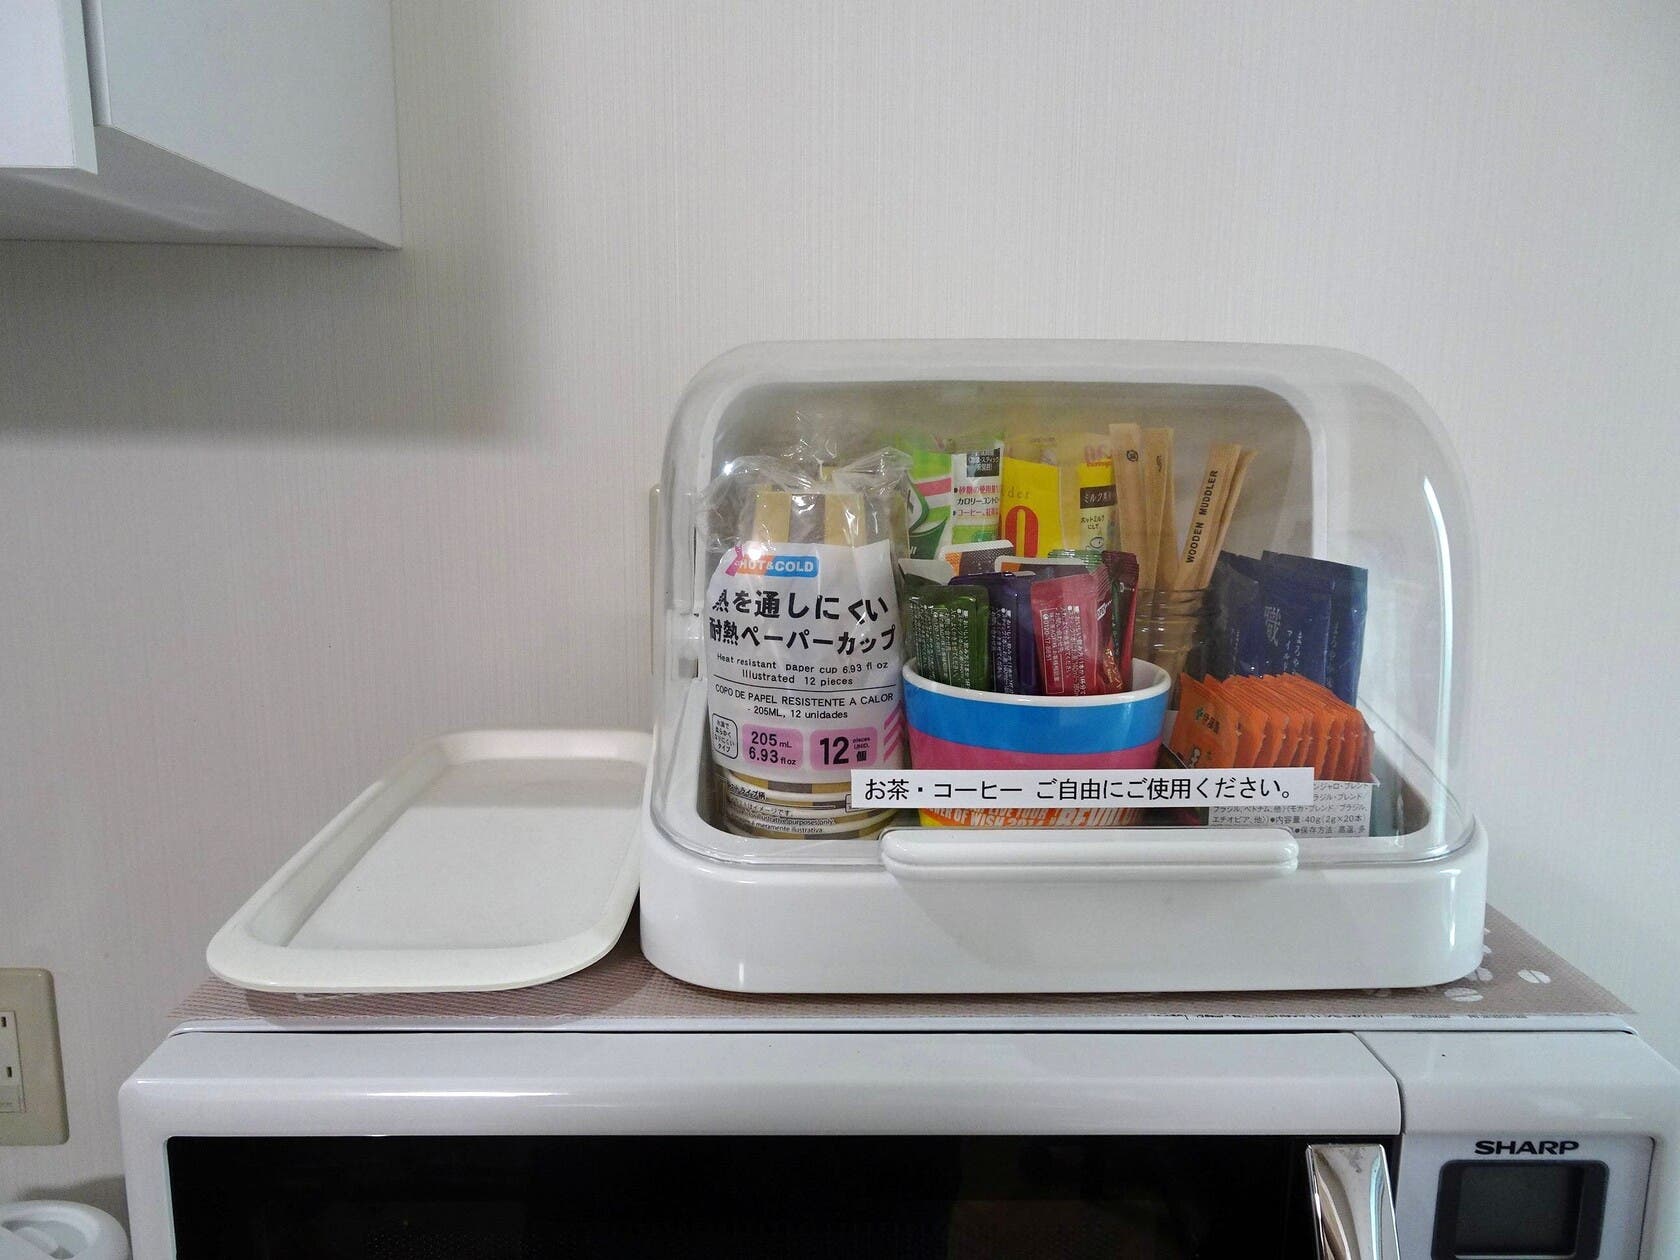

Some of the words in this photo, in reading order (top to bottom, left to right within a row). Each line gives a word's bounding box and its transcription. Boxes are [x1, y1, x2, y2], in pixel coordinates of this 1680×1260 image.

[1185, 522, 1204, 563] WOODEN
[1199, 470, 1218, 515] MUDDLER
[709, 617, 896, 656] 耐熱ペーパーカップ
[717, 652, 734, 664] Heat
[736, 658, 777, 669] resistant
[785, 664, 815, 673] paper
[819, 667, 838, 675] cup
[842, 663, 862, 674] 6.93
[876, 661, 889, 670] oz
[742, 669, 795, 684] Illustrated
[804, 676, 816, 686] 12
[820, 677, 853, 687] pieces
[715, 683, 734, 697] COPO
[735, 689, 746, 699] DE
[748, 692, 778, 704] PAPEL
[781, 695, 846, 707] RESISTENTE
[849, 697, 857, 706] A
[860, 692, 894, 705] CALOR
[791, 709, 802, 719] 12
[804, 711, 848, 719] unidades
[751, 731, 778, 746] 205
[748, 746, 779, 763] 6.93
[819, 736, 849, 765] 12
[865, 778, 1022, 801] お茶・コーヒー
[1036, 777, 1290, 801] ご自由にご使用ください。
[1474, 1140, 1580, 1156] SHARP
